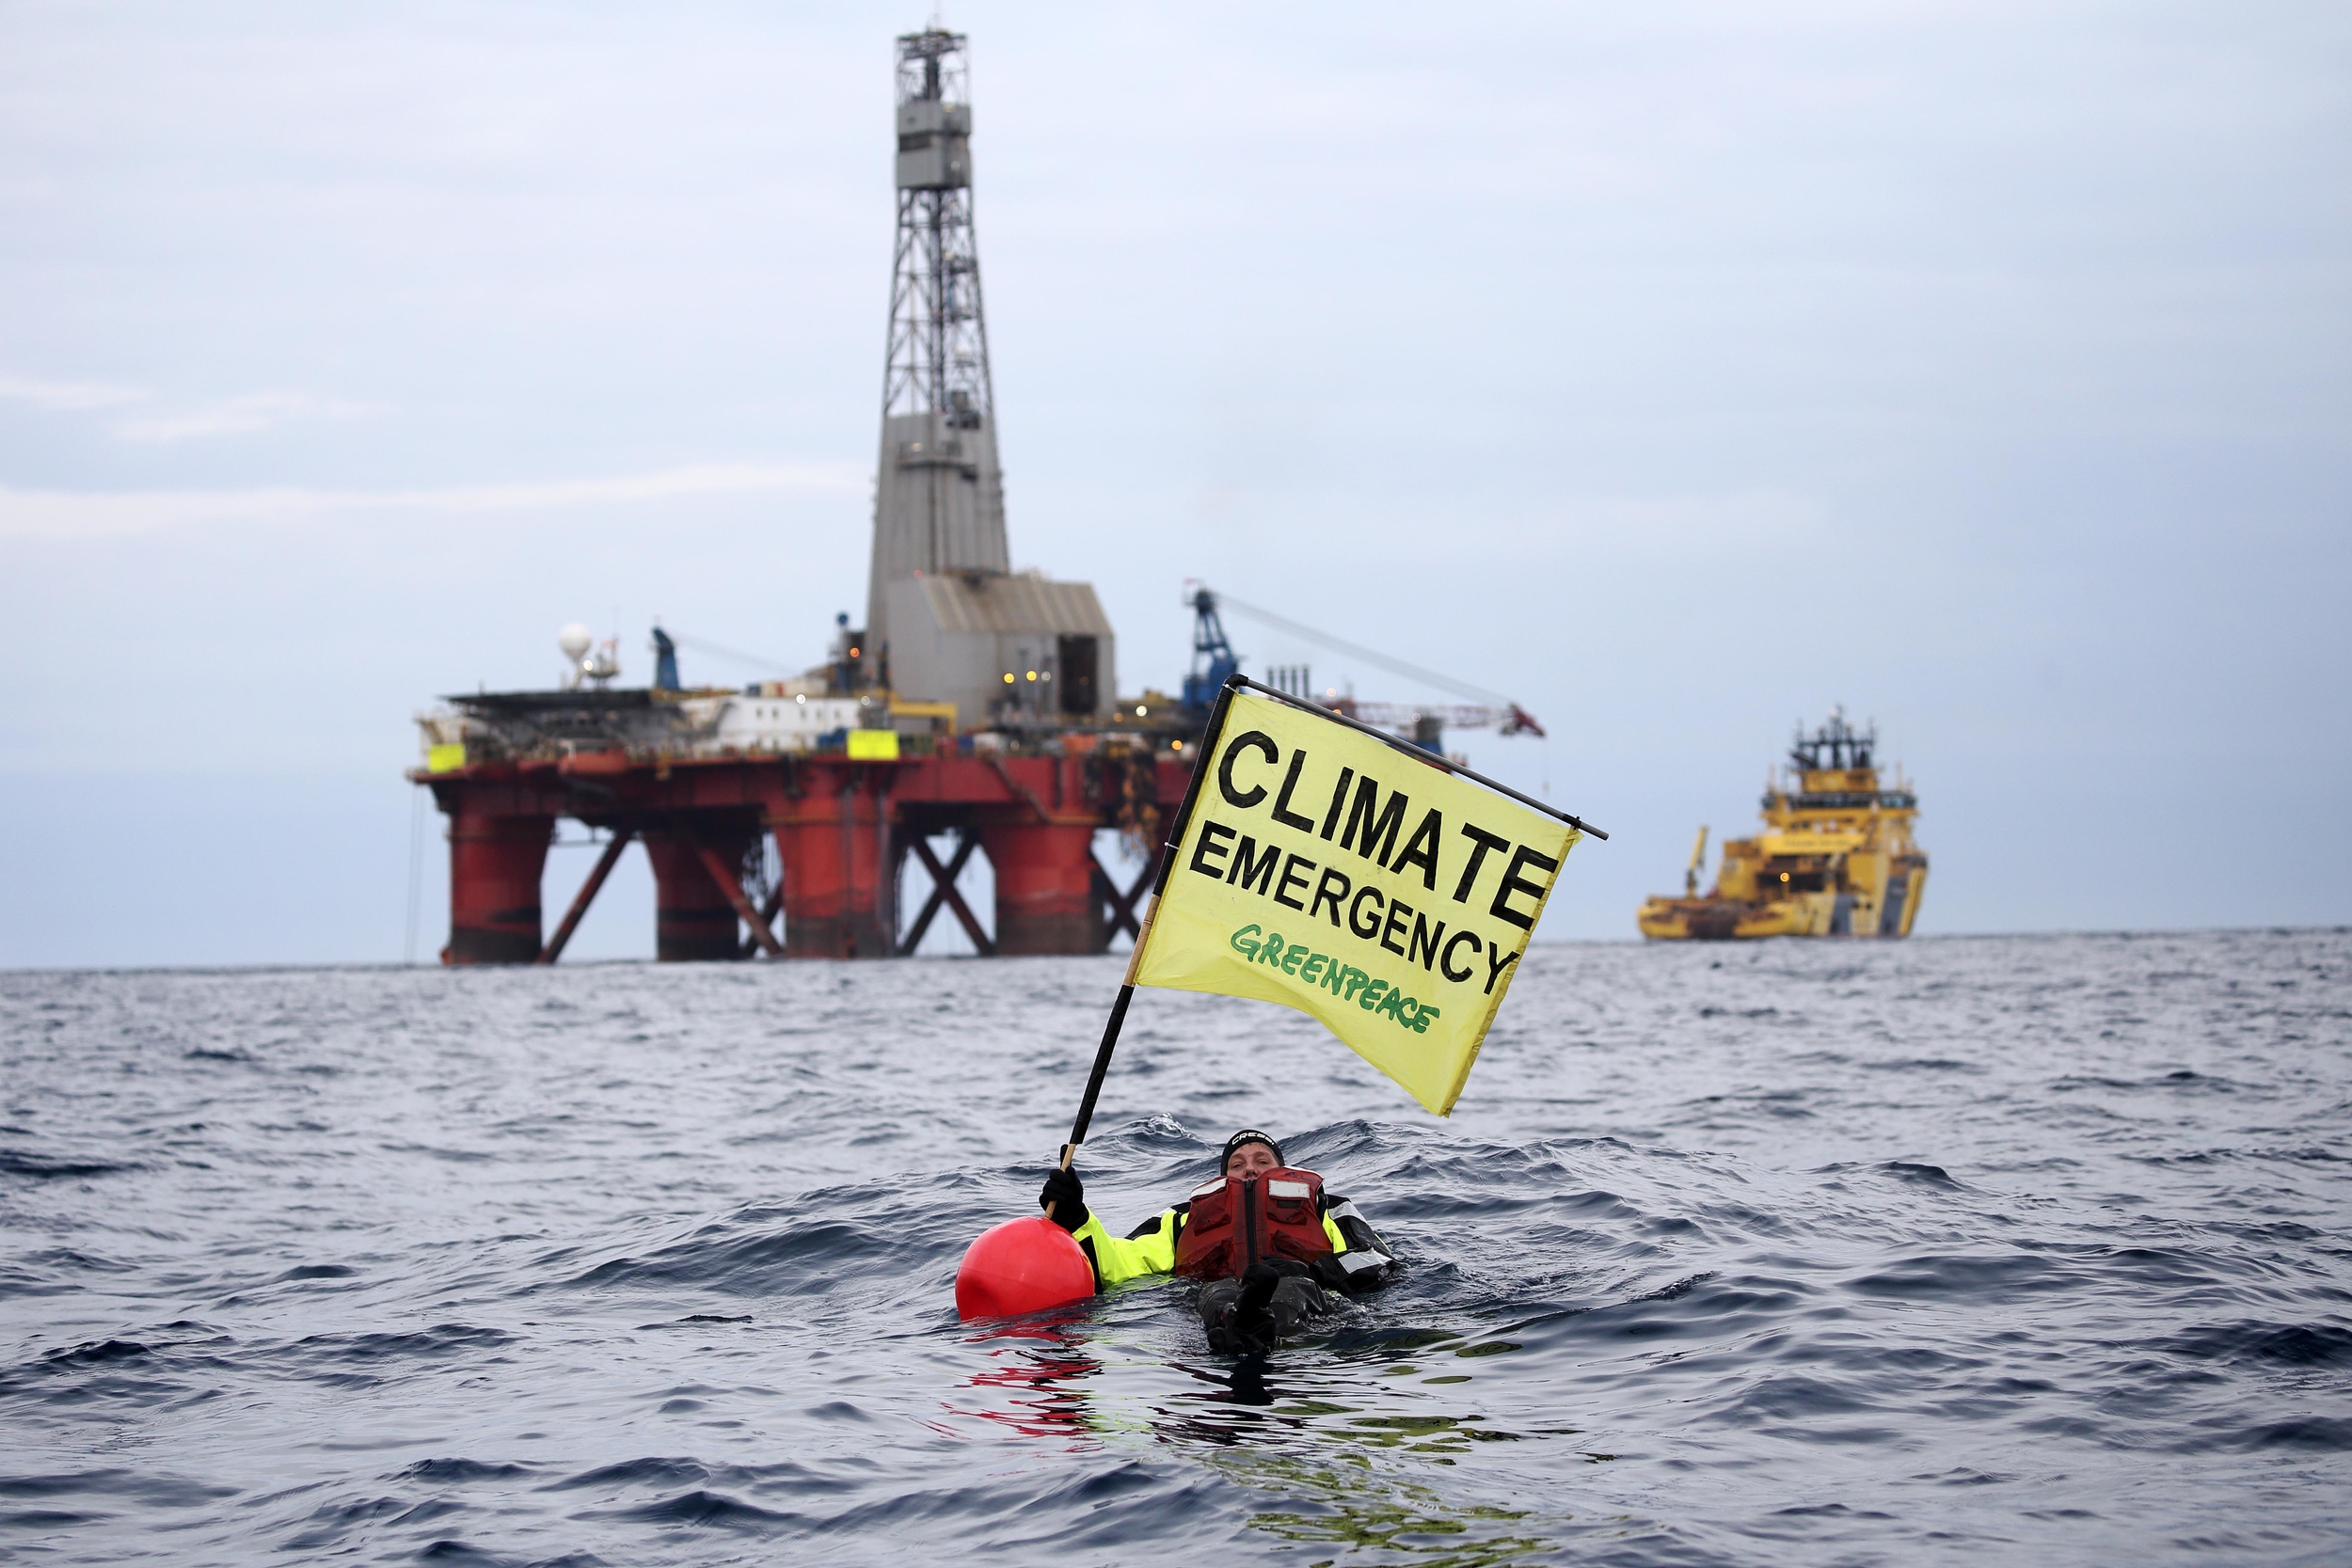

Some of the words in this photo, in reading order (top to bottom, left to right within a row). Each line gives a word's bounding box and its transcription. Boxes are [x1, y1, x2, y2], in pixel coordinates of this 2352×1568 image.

[1190, 820, 1520, 995] EMERGENCY
[1218, 731, 1559, 931] CLIMATE
[1231, 924, 1439, 1033] GREENPEACE
